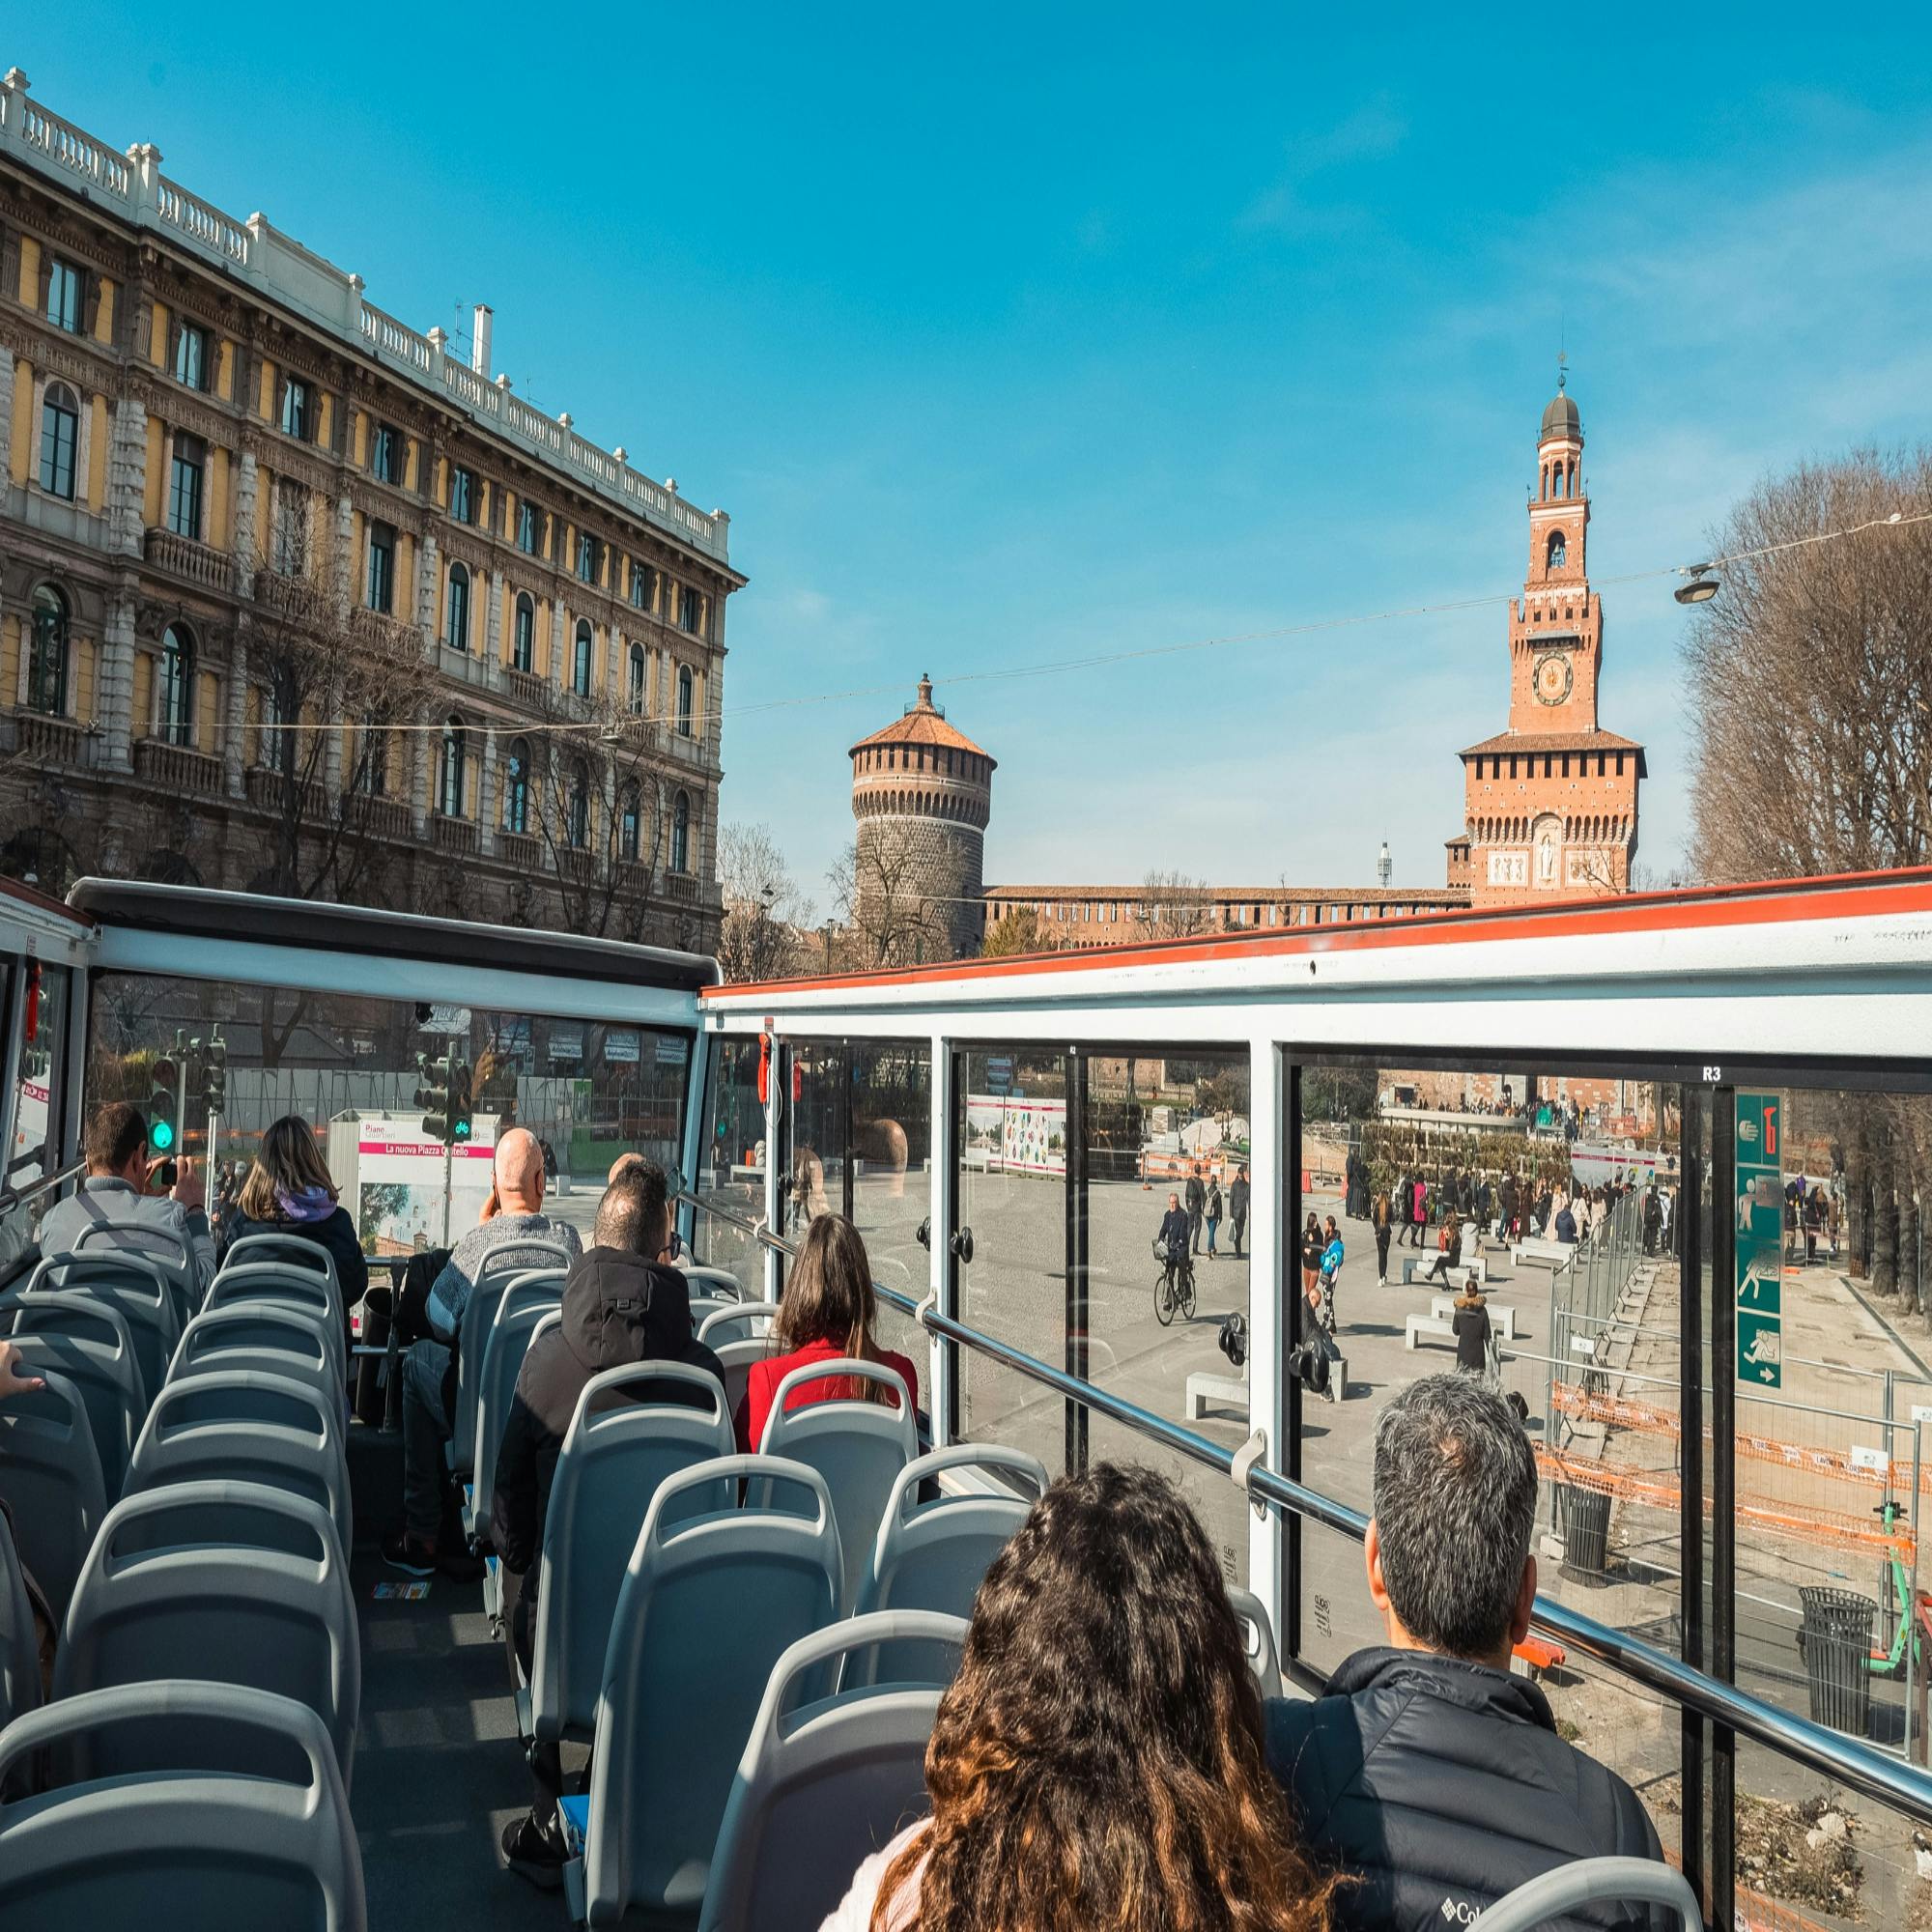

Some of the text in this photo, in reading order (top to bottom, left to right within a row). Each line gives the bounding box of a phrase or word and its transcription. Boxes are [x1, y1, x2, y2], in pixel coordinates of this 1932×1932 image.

[1703, 1066, 1720, 1081] R3
[366, 1123, 384, 1133] Piano
[386, 1143, 469, 1156] La nuova Piazza Ctello
